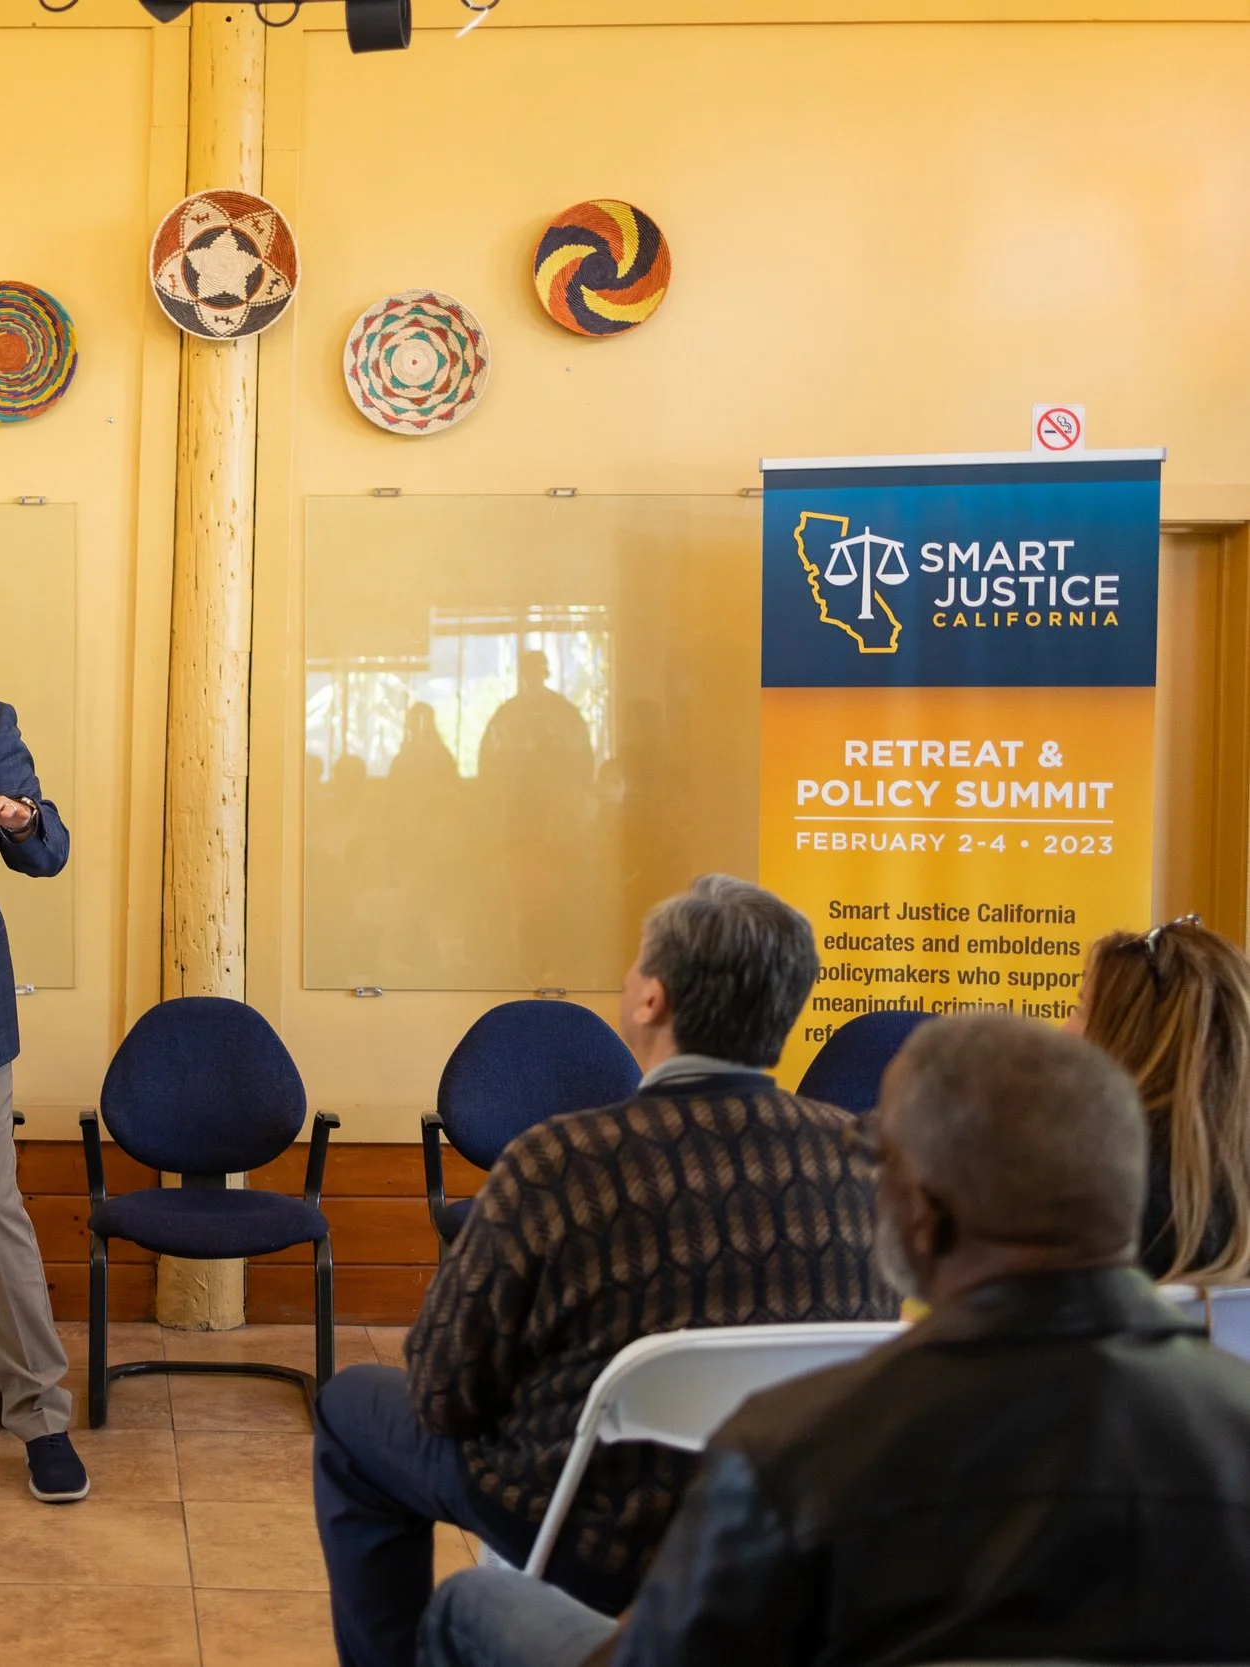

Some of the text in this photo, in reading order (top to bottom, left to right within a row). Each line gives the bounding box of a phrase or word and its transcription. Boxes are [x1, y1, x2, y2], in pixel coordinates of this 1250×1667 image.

[919, 540, 1075, 573] SMART
[933, 575, 1120, 608] JUSTICE
[932, 611, 1119, 628] CALIFORNIA
[845, 740, 1064, 768] RETREAT &
[797, 780, 1114, 809] POLICY SUMMIT
[796, 832, 1113, 854] FEBRUARY 2-4 2023
[829, 900, 1076, 924] Smart Justice California
[823, 931, 1081, 956] educates and emboldens
[816, 963, 950, 986] policymakers
[957, 966, 1001, 986] who
[1022, 999, 1078, 1020] justic
